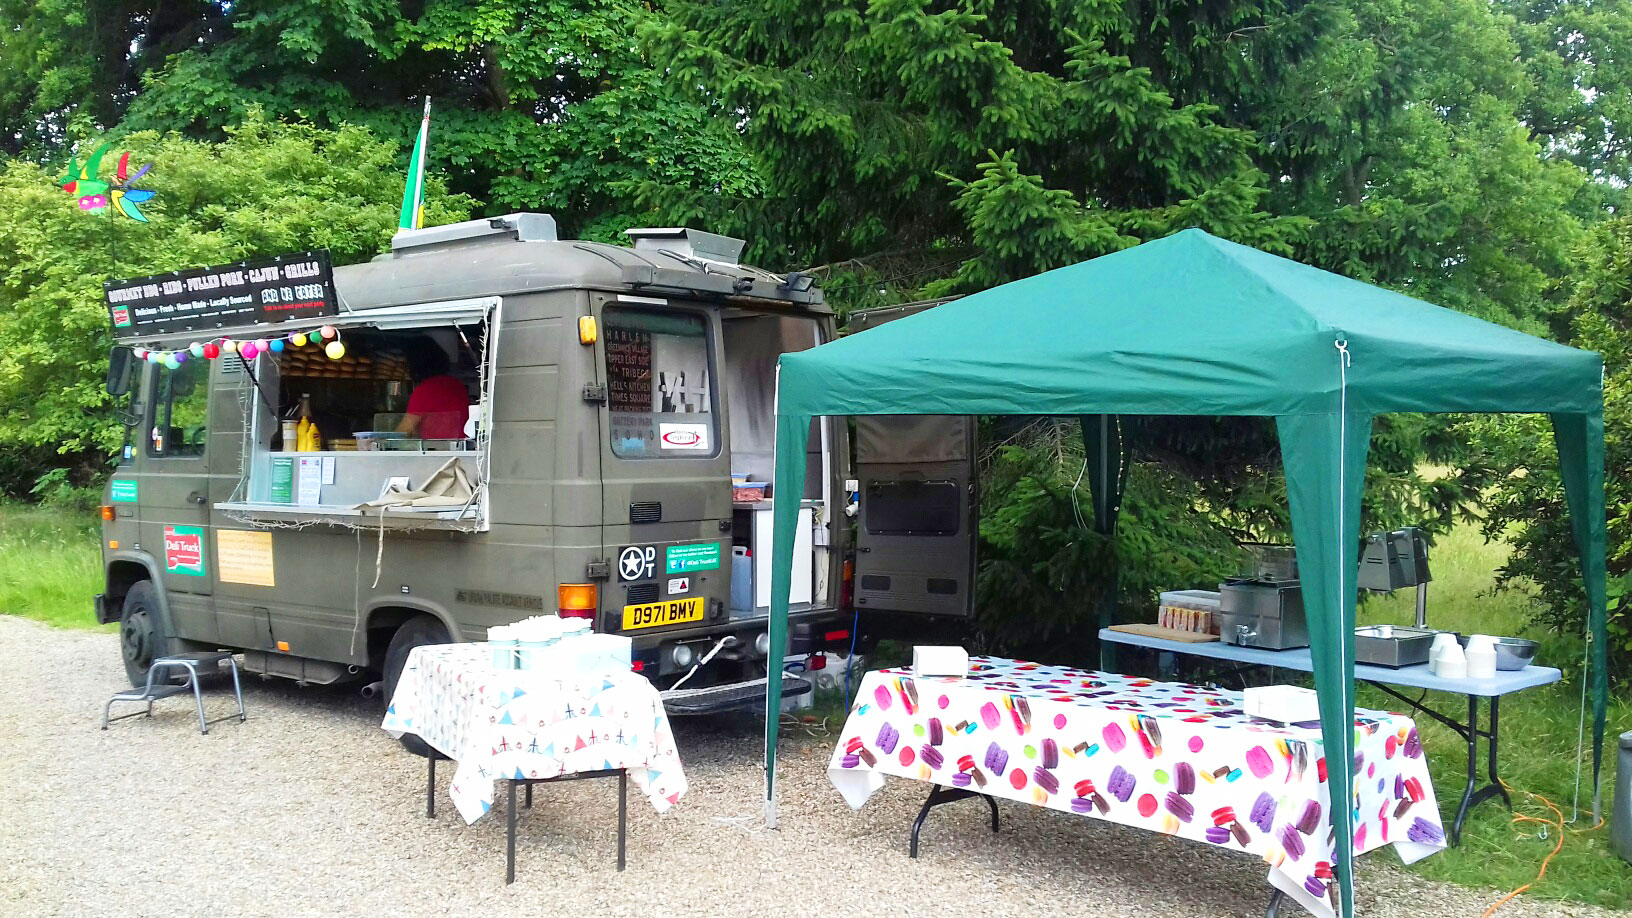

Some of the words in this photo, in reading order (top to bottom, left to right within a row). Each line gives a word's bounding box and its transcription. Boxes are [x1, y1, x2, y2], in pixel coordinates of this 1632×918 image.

[187, 274, 220, 292] PULLED
[220, 270, 245, 288] PORK
[248, 266, 280, 283] CAJUN
[284, 261, 320, 279] GRILLS
[209, 297, 230, 308] Locally
[229, 293, 253, 305] Sourced
[261, 288, 279, 304] AND
[294, 283, 324, 300] CATER
[606, 329, 649, 343] HARLEM
[625, 355, 638, 365] EAST
[621, 367, 650, 379] TRIBEC
[166, 540, 180, 550] Deli
[179, 541, 200, 552] Truck
[645, 546, 656, 562] D
[645, 563, 655, 578] T
[633, 606, 666, 626] D971
[668, 601, 696, 621] BMV
